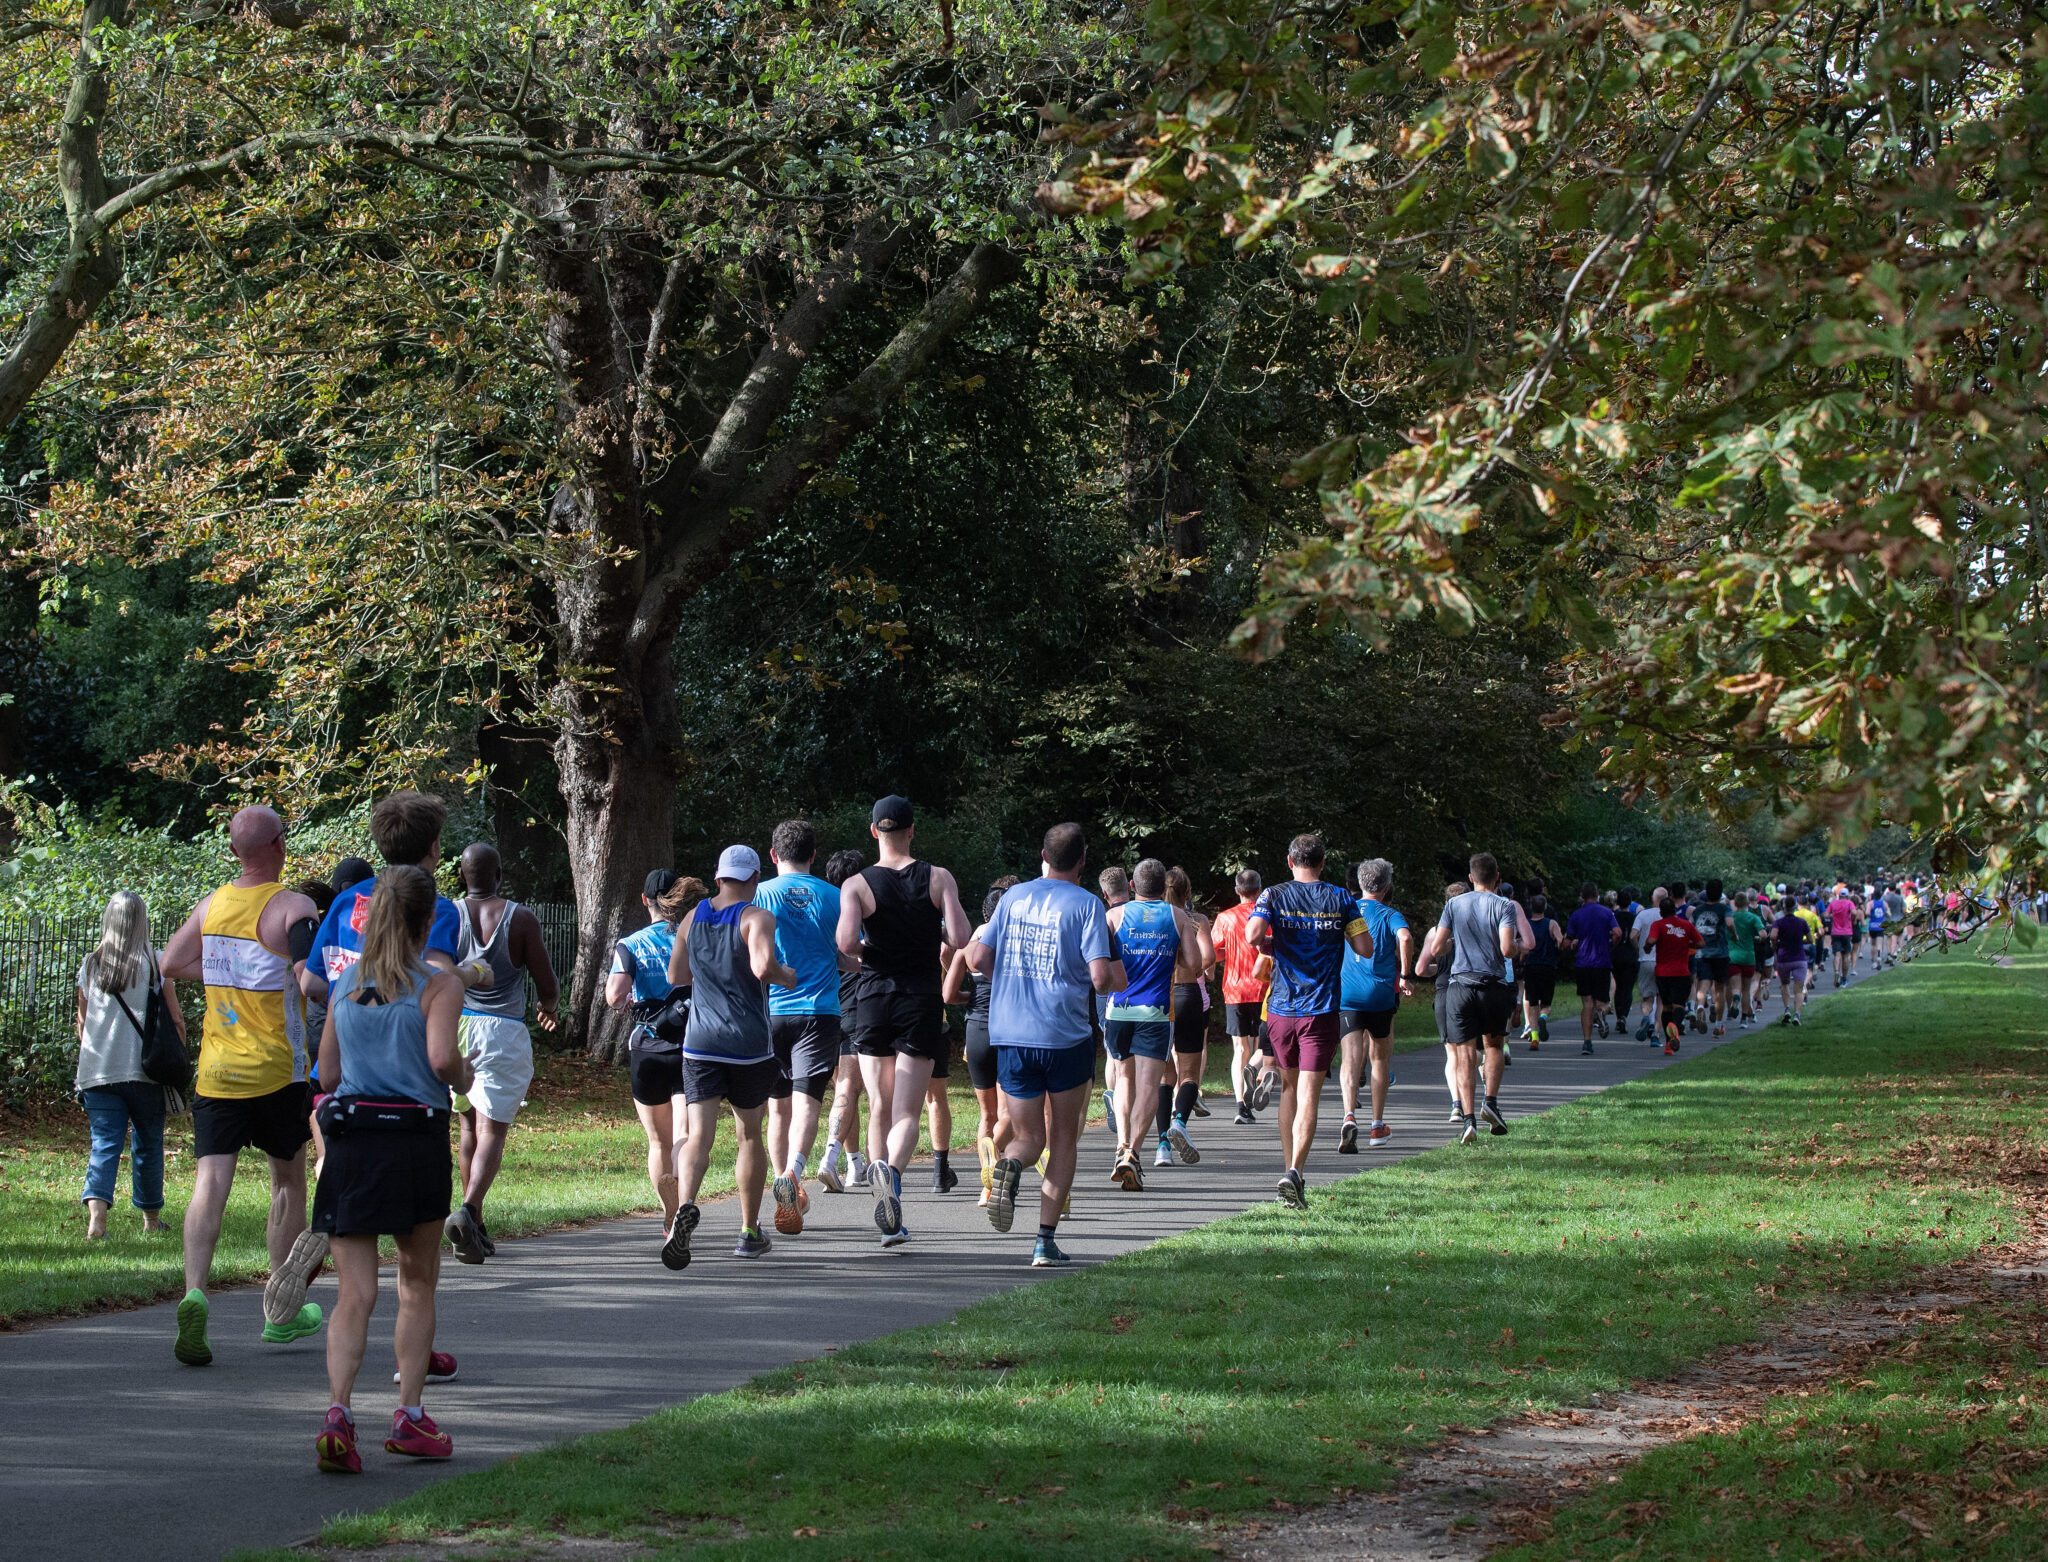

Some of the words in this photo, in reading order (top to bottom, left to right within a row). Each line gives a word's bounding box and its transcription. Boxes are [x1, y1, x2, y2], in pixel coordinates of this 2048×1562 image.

[1312, 911, 1319, 919] of
[1279, 917, 1312, 930] TEAM
[1314, 920, 1342, 930] RBC
[1006, 924, 1059, 942] FINISHER
[1127, 927, 1169, 939] Faversham
[1004, 939, 1057, 957] FINISHER
[1122, 943, 1157, 958] Running
[1158, 944, 1174, 957] Club
[1003, 953, 1055, 972] FINISHER
